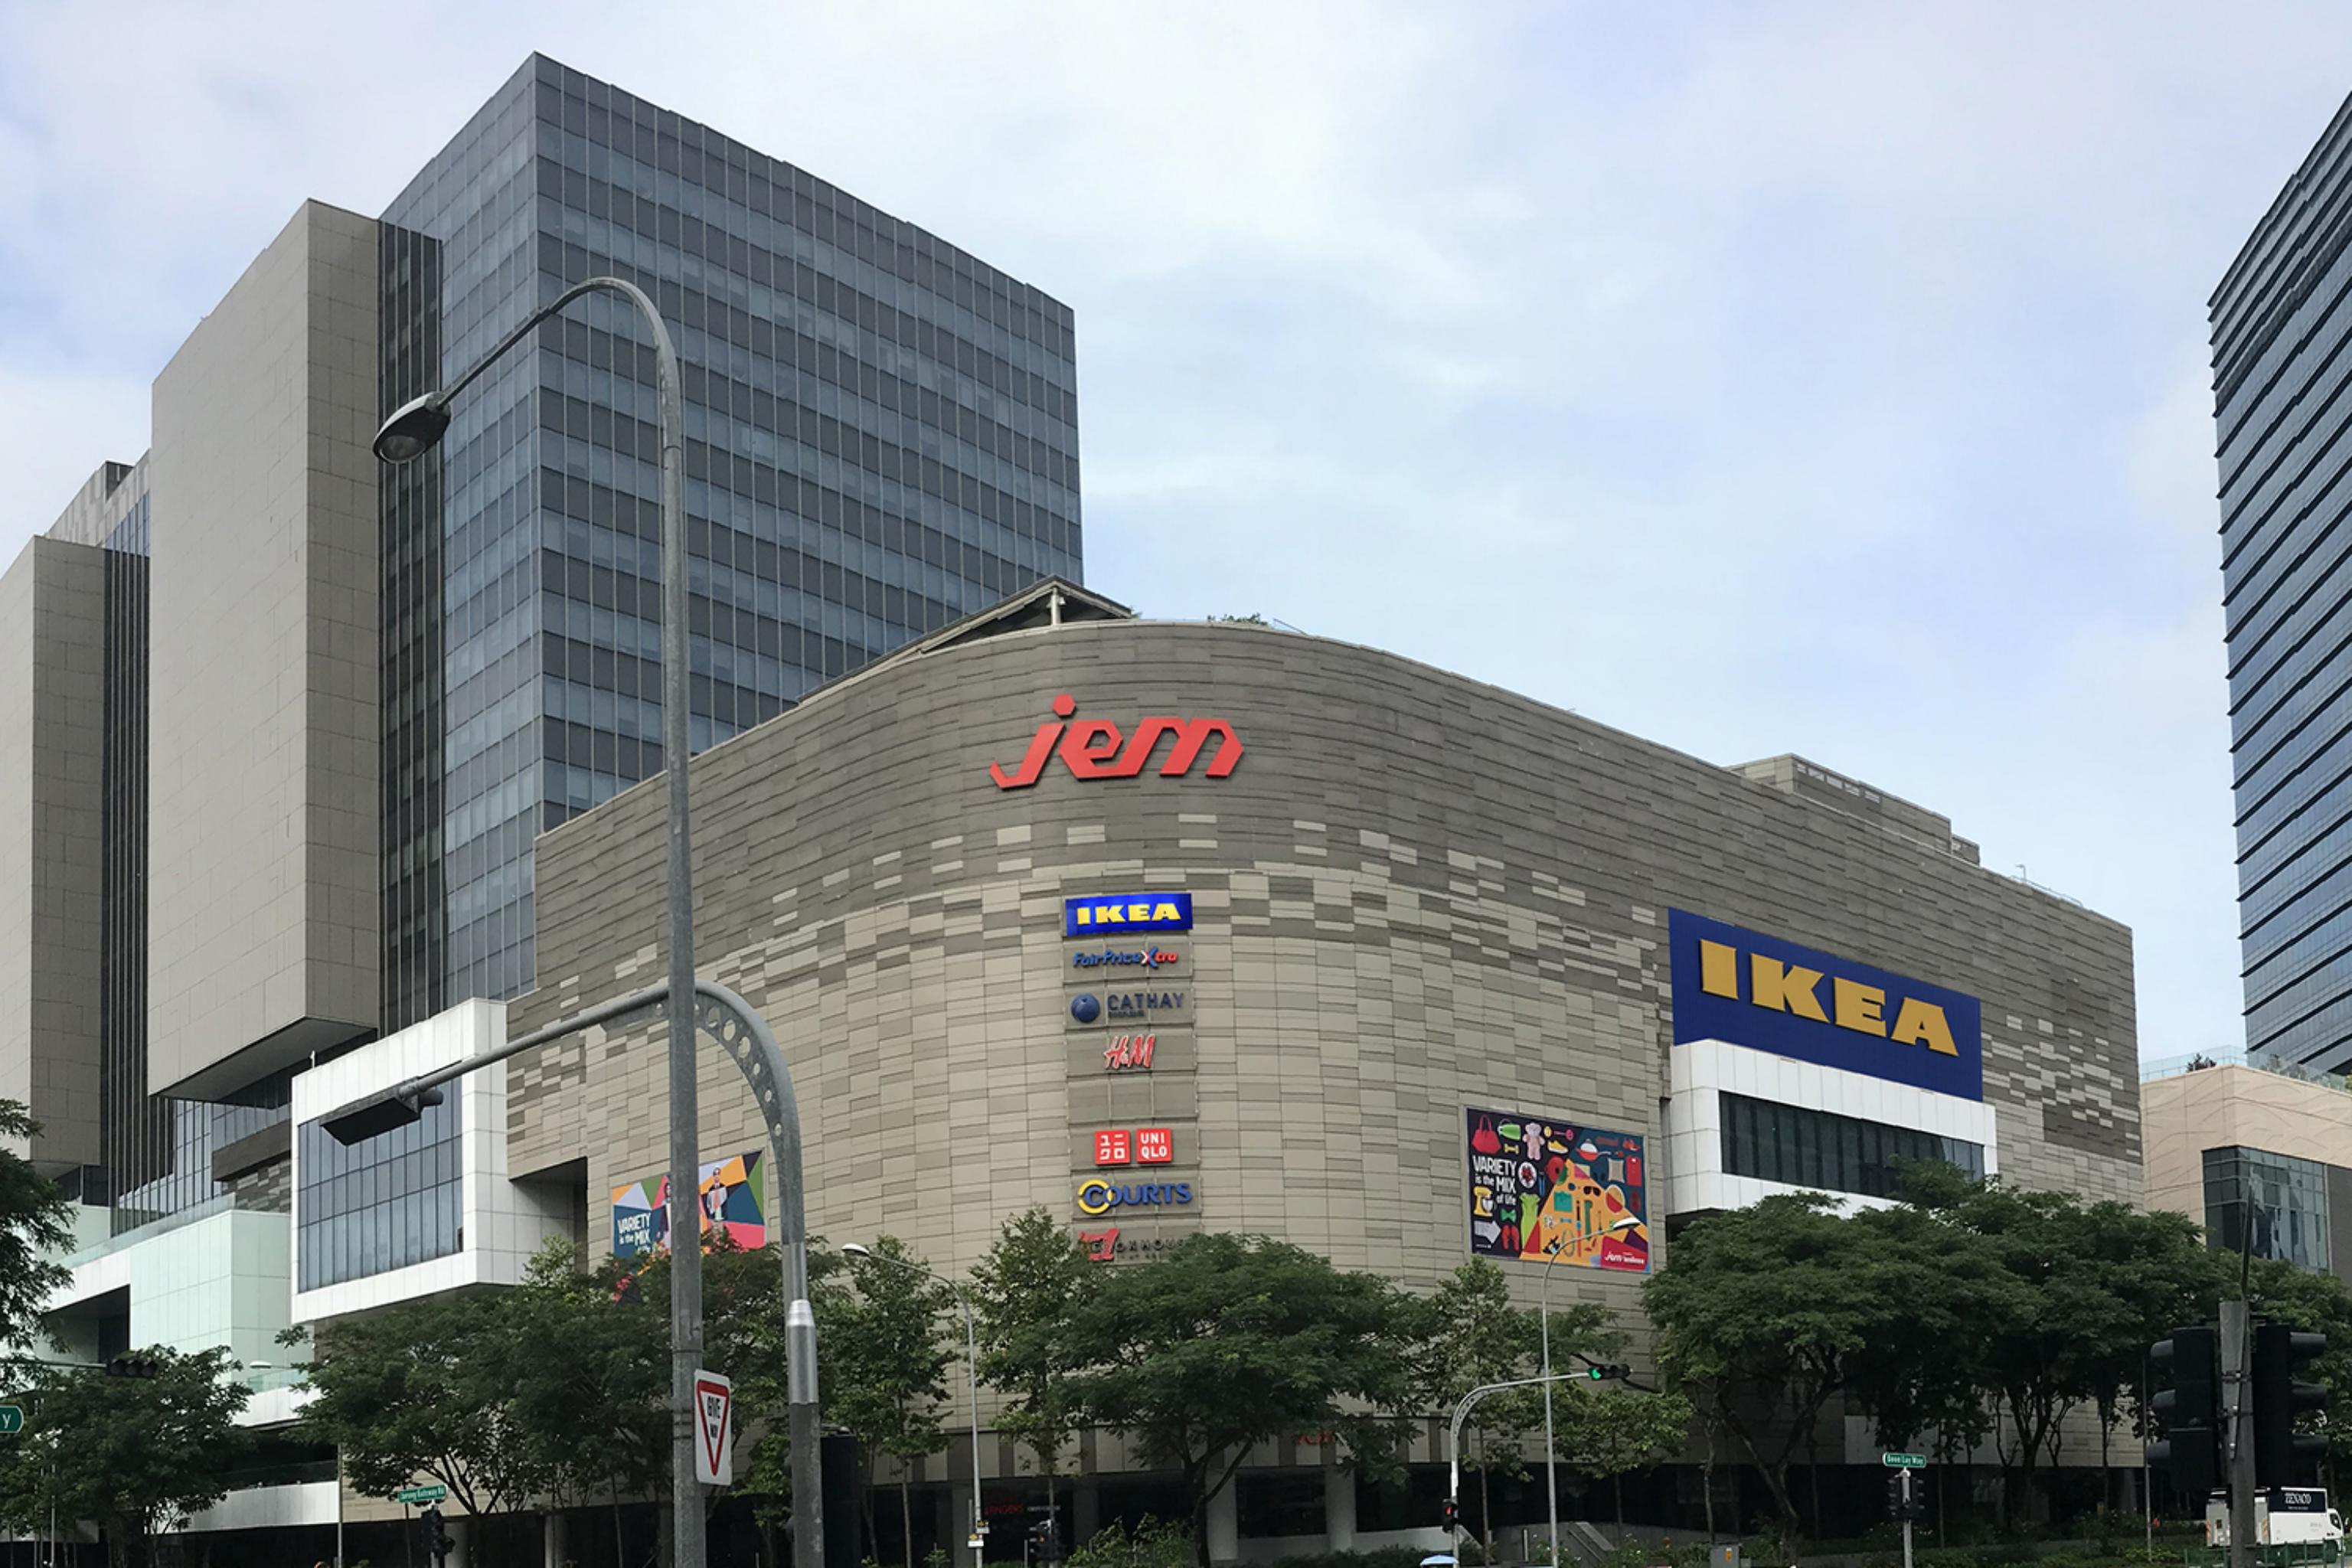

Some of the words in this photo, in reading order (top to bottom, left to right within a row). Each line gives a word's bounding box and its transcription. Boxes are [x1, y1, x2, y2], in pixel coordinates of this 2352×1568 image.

[989, 694, 1244, 789] jem
[1076, 903, 1181, 925] IKEA
[1107, 992, 1184, 1010] CATHAY
[1700, 939, 1959, 1057] IKEA
[1104, 1034, 1155, 1069] H&M
[1472, 1155, 1517, 1177] VARIETY
[1496, 1176, 1517, 1194] MIX
[1078, 1179, 1192, 1214] COURTS
[617, 1212, 651, 1233] VARIETY
[635, 1229, 651, 1246] MIX
